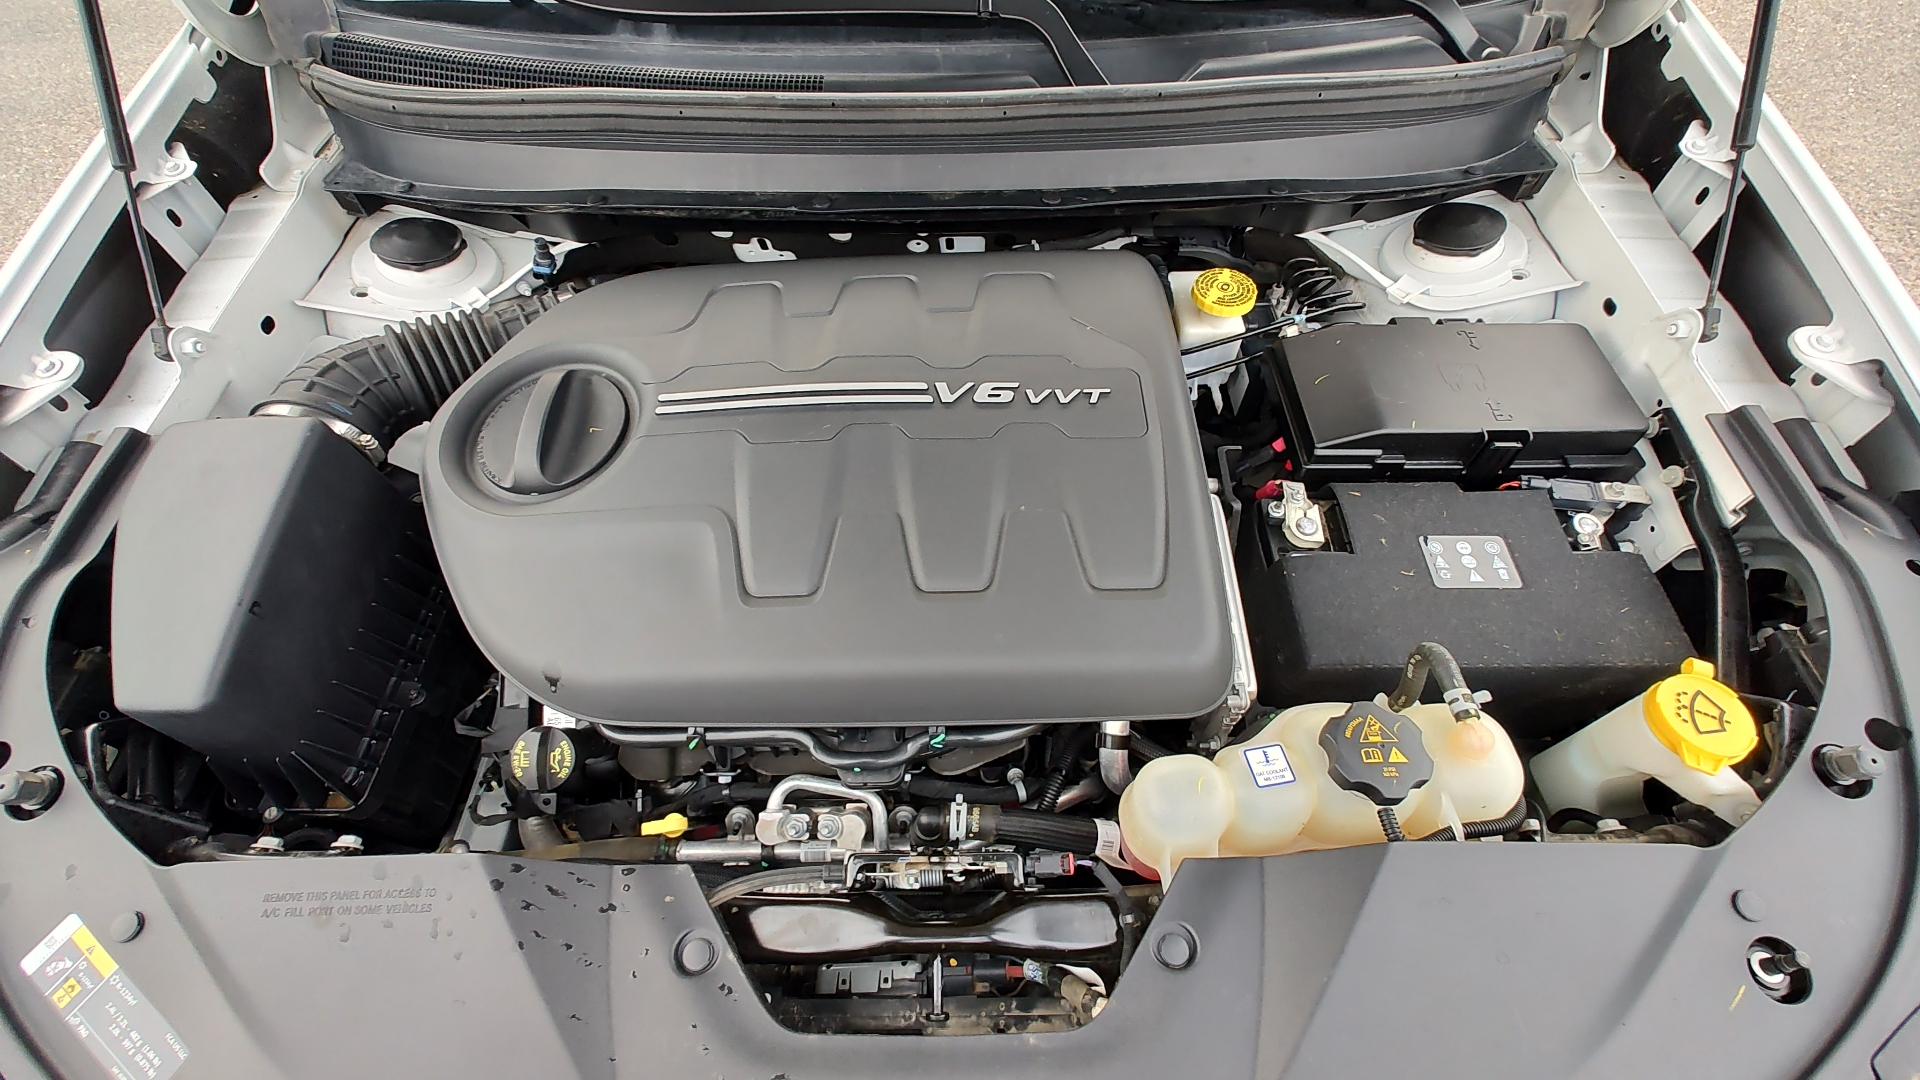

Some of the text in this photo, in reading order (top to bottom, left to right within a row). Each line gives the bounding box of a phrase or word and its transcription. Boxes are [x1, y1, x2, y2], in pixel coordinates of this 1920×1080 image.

[934, 381, 1111, 404] V6 VVT
[557, 740, 571, 778] ENGINE OIL
[1266, 767, 1288, 775] COOLANT
[263, 888, 436, 902] REMOVE THIS PANEL FOR ACCESS TO
[261, 903, 432, 918] A/C FILL PORT ON SOME VEHICLES
